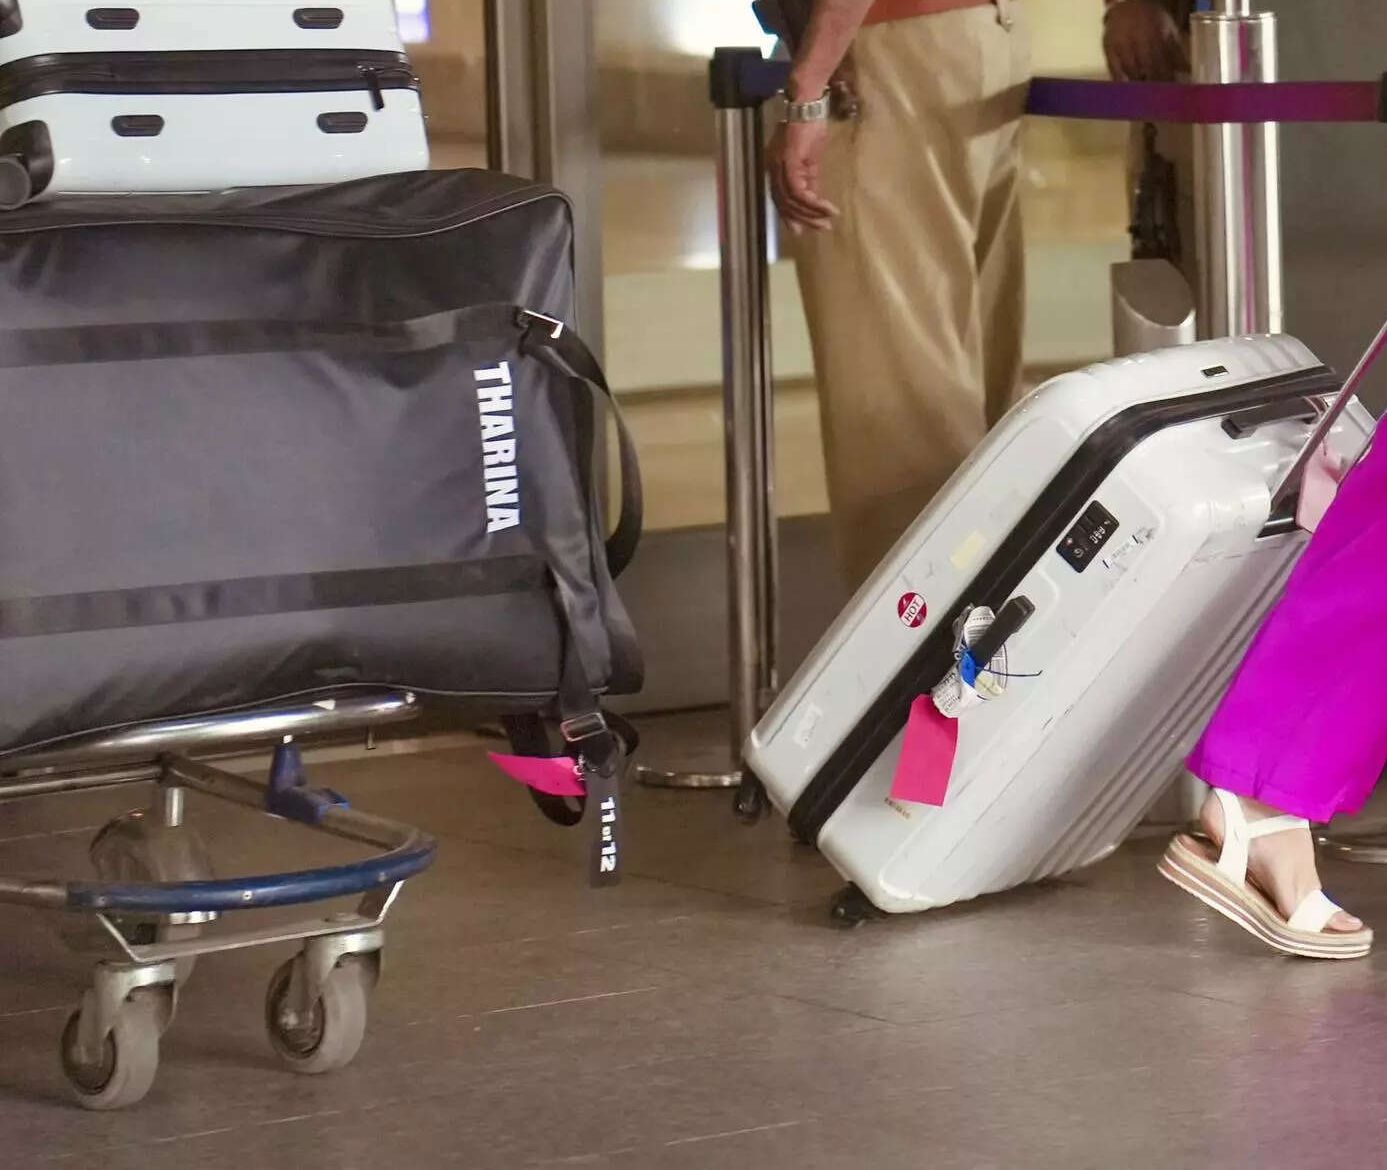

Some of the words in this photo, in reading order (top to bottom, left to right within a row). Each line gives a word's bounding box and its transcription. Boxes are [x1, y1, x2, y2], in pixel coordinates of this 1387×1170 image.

[474, 361, 520, 533] THARINA
[904, 599, 920, 622] HOT
[600, 797, 616, 823] 11
[600, 841, 617, 872] 12
